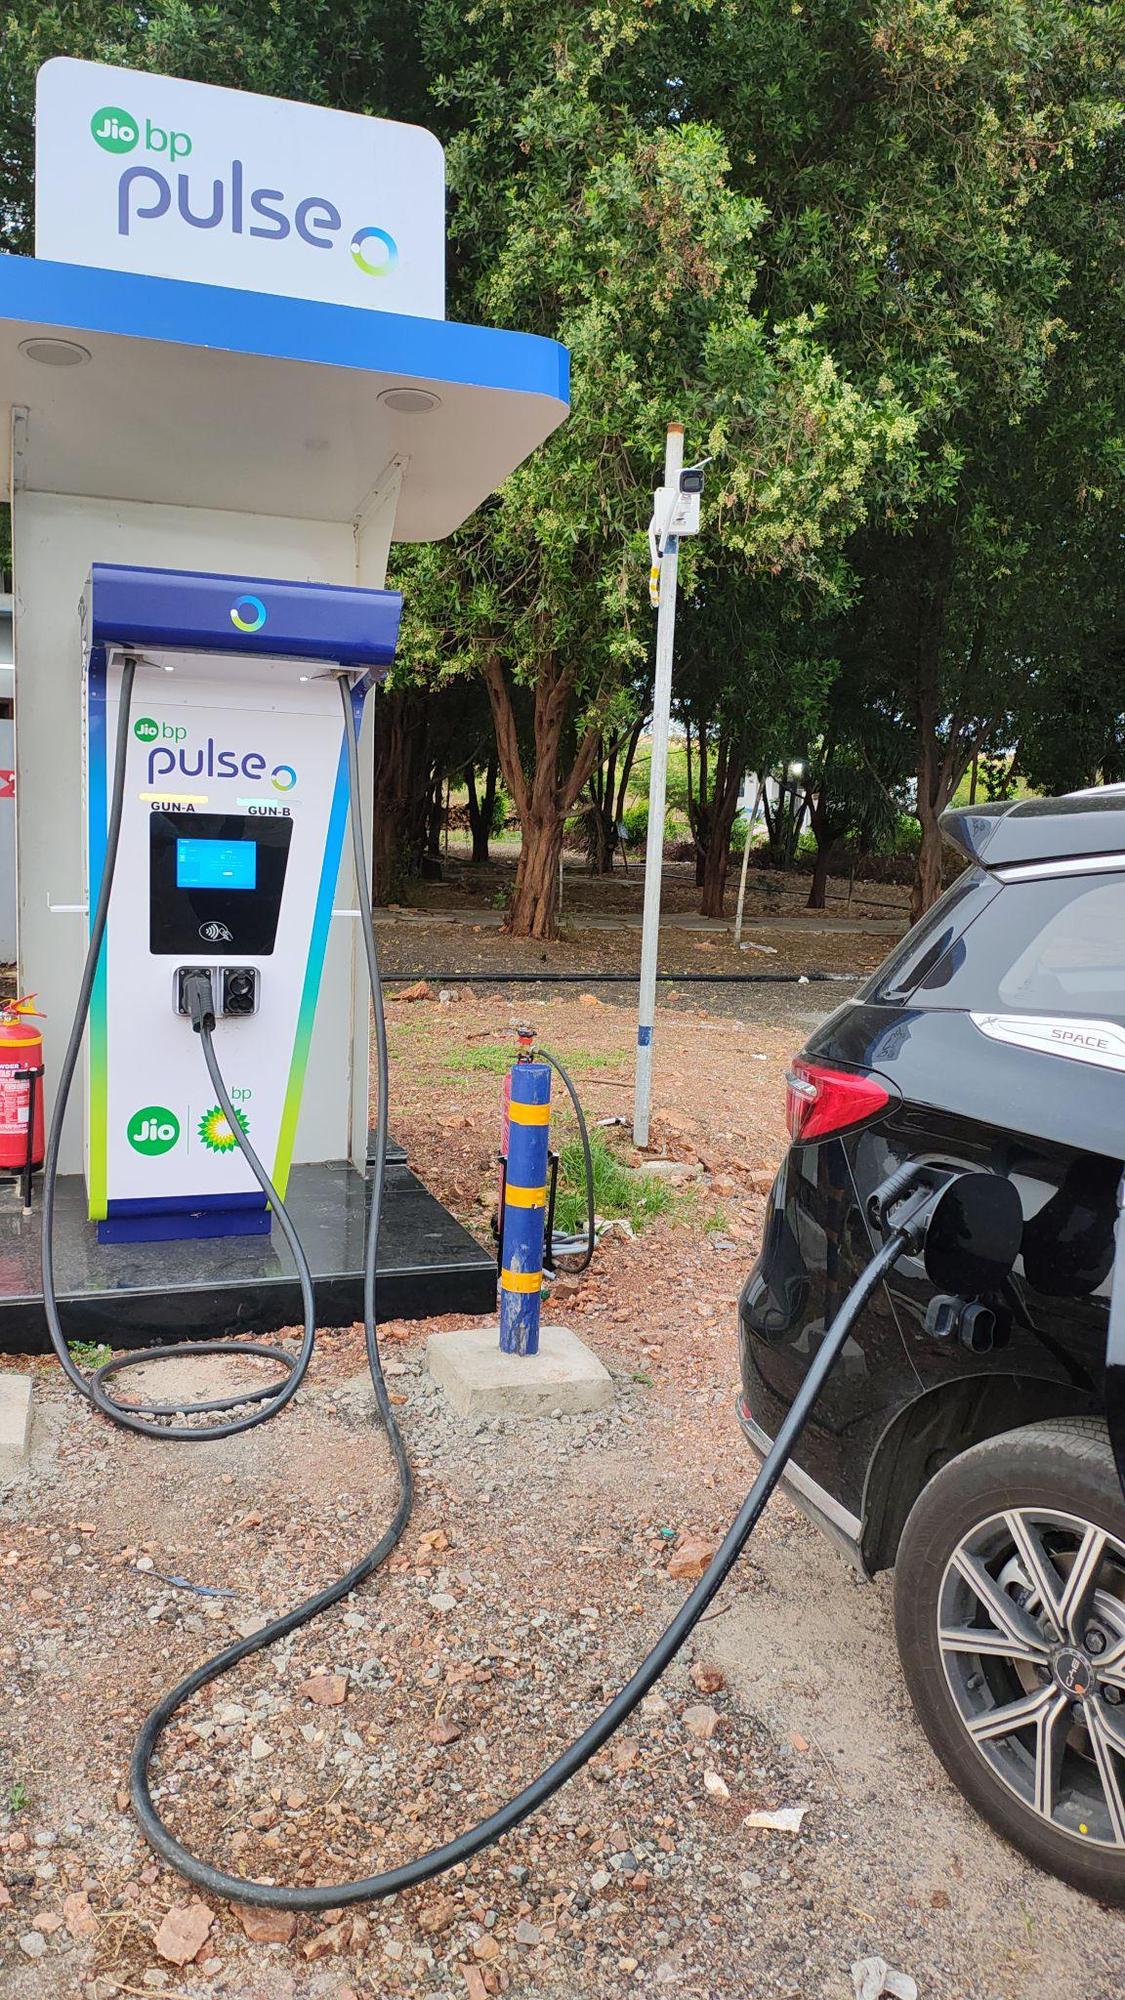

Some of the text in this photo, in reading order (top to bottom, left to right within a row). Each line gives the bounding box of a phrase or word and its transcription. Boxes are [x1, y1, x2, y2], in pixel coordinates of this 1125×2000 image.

[96, 117, 193, 162] Jio bp
[118, 159, 342, 250] pulse
[162, 722, 187, 743] bp
[148, 738, 266, 784] pulse
[150, 801, 195, 813] GUN-A
[247, 805, 291, 816] GUN-B
[1051, 1028, 1109, 1049] SPACE
[231, 1086, 252, 1102] bp
[133, 1118, 176, 1141] Jio
